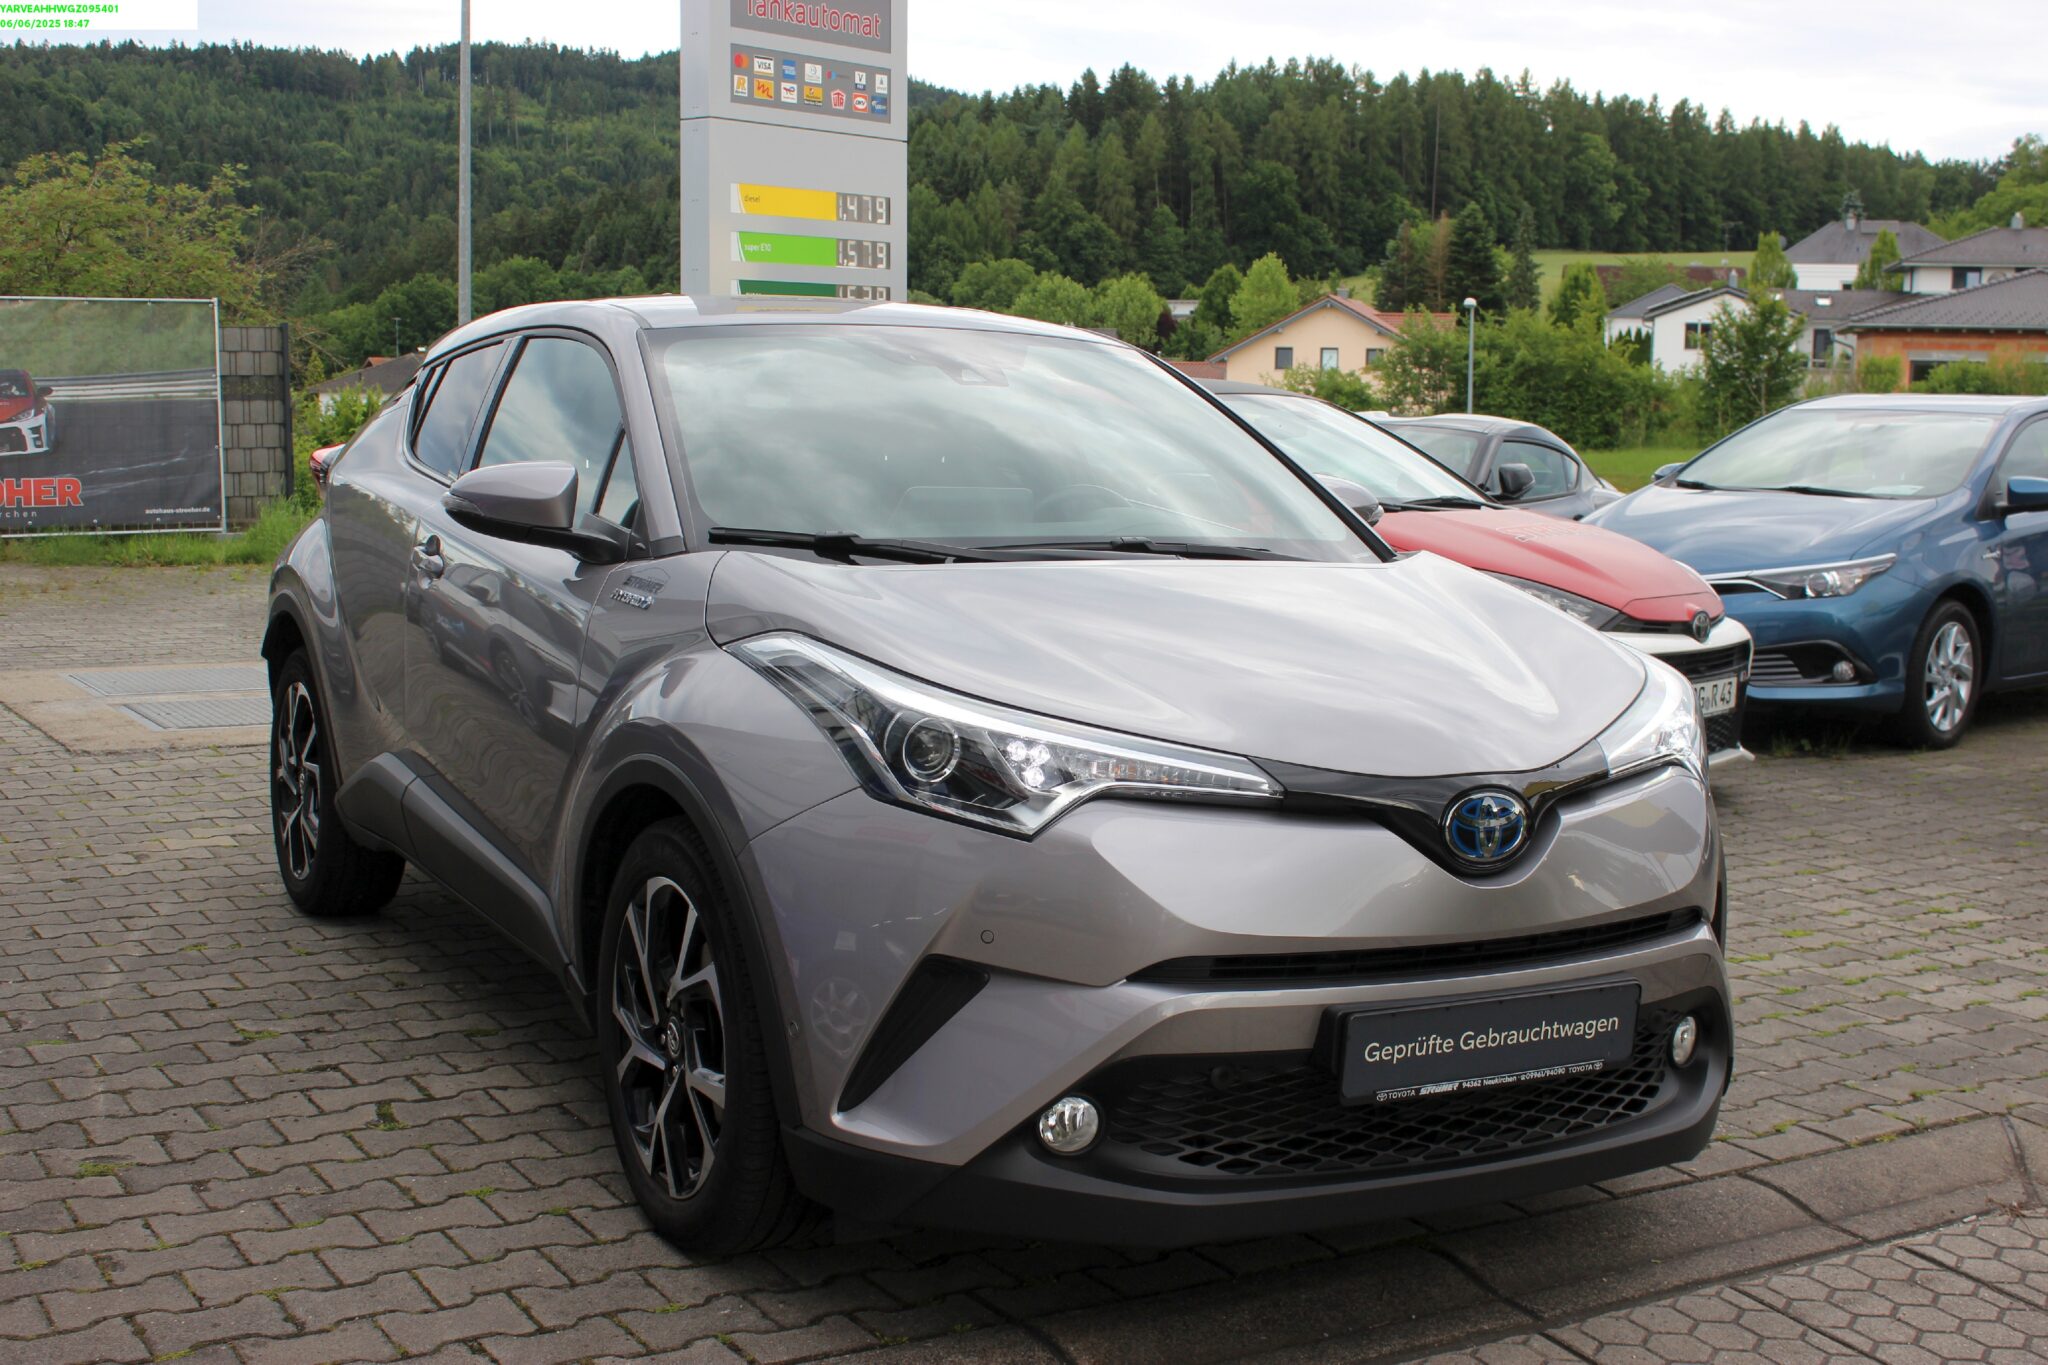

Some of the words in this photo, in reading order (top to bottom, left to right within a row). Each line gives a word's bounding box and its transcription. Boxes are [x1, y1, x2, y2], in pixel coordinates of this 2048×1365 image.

[757, 61, 772, 70] VISA
[1720, 681, 1732, 704] 43
[1364, 1034, 1454, 1064] Geprüfte
[1460, 1016, 1619, 1051] Gebrauchtwagen
[1388, 1089, 1416, 1099] TOYOTA
[1462, 1079, 1482, 1089] 94362
[1483, 1074, 1517, 1086] Neukirchen
[1568, 1064, 1593, 1074] TOYOTA
